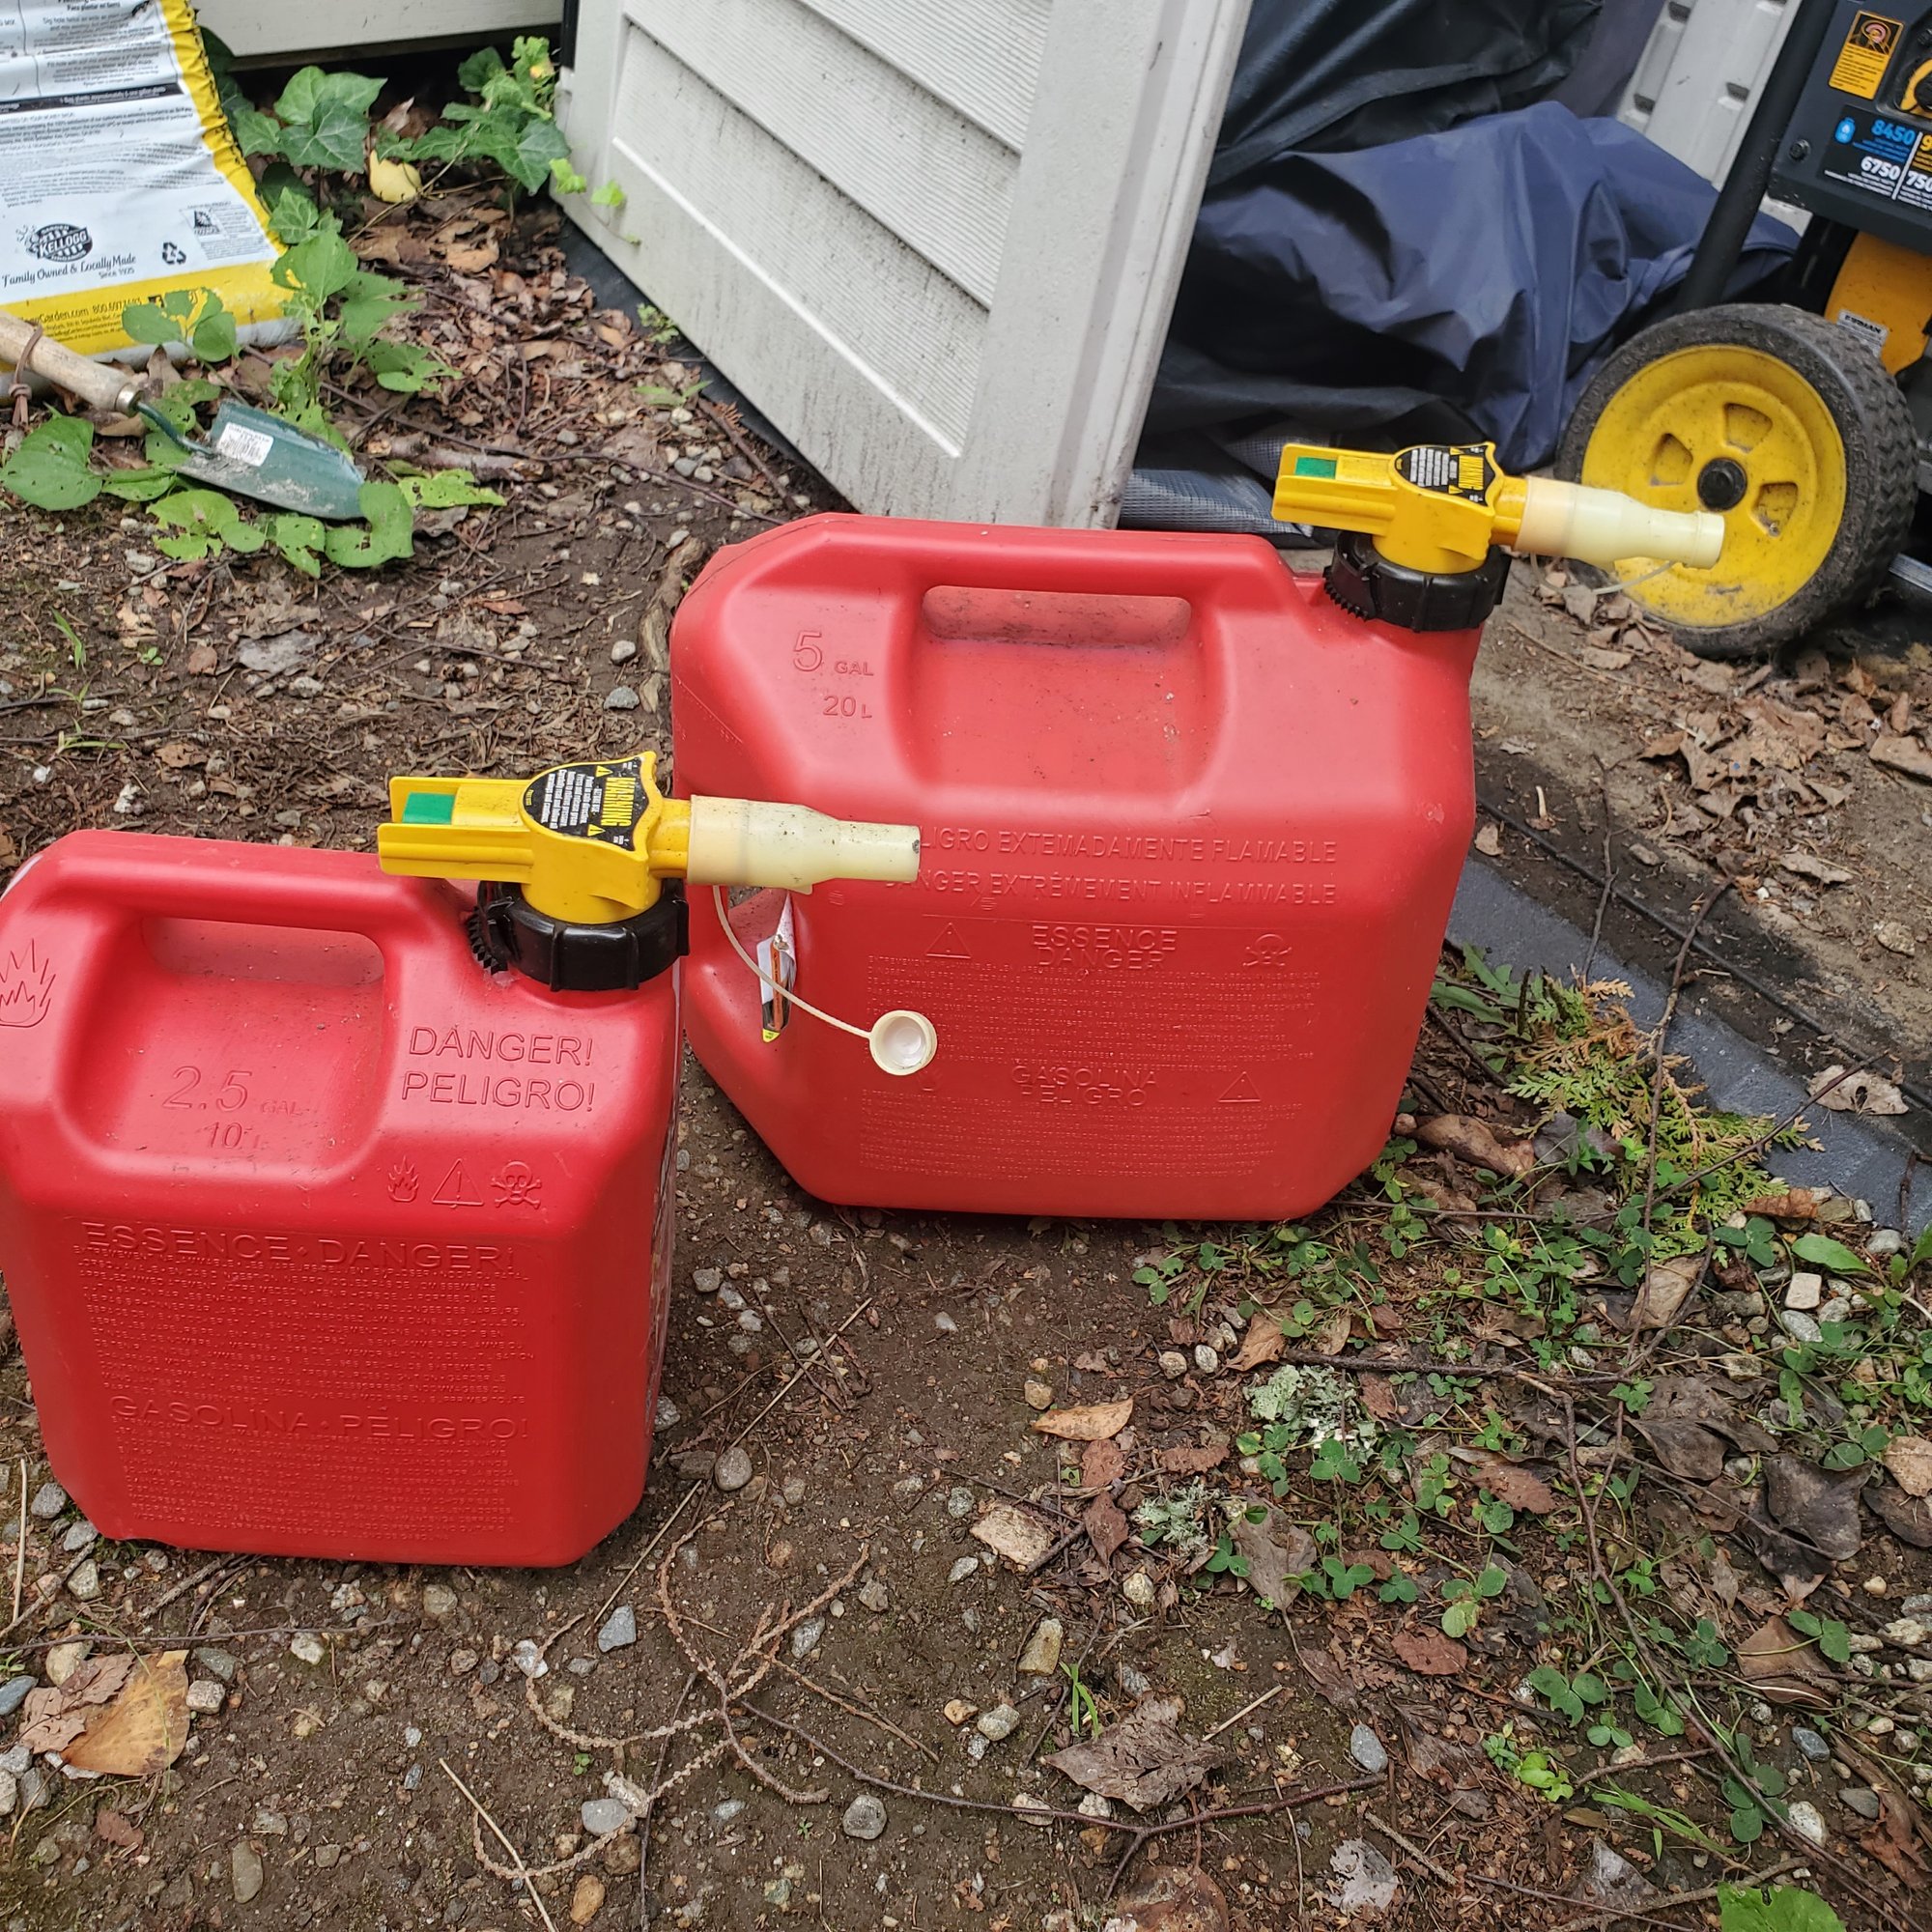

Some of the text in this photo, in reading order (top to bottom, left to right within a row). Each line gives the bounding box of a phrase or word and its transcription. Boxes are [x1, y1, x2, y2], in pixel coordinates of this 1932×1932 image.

[1871, 119, 1917, 146] 8450
[1861, 156, 1901, 181] 6750
[39, 229, 88, 258] KELLOGG
[2, 253, 137, 288] Family Owned & Locally Made
[792, 630, 874, 676] 5 GAL
[601, 777, 637, 826] WARNING
[920, 825, 1337, 864] LIGRO EXTEMADAMENTE FLAMABLE
[1169, 881, 1337, 904] INFLAMMABLE
[1031, 923, 1178, 952] ESSENCE
[1036, 945, 1166, 970] DANGER
[409, 1026, 593, 1066] DANGER!
[161, 1065, 303, 1117] 2.5 GAL
[401, 1069, 595, 1112] PELIGRO!
[1011, 1065, 1159, 1089] GASOLINA
[1020, 1083, 1148, 1107] PELIGRO
[81, 1221, 514, 1270] ESSENCE DANGER!
[110, 1395, 529, 1438] GASOLINA PELIGRO!
